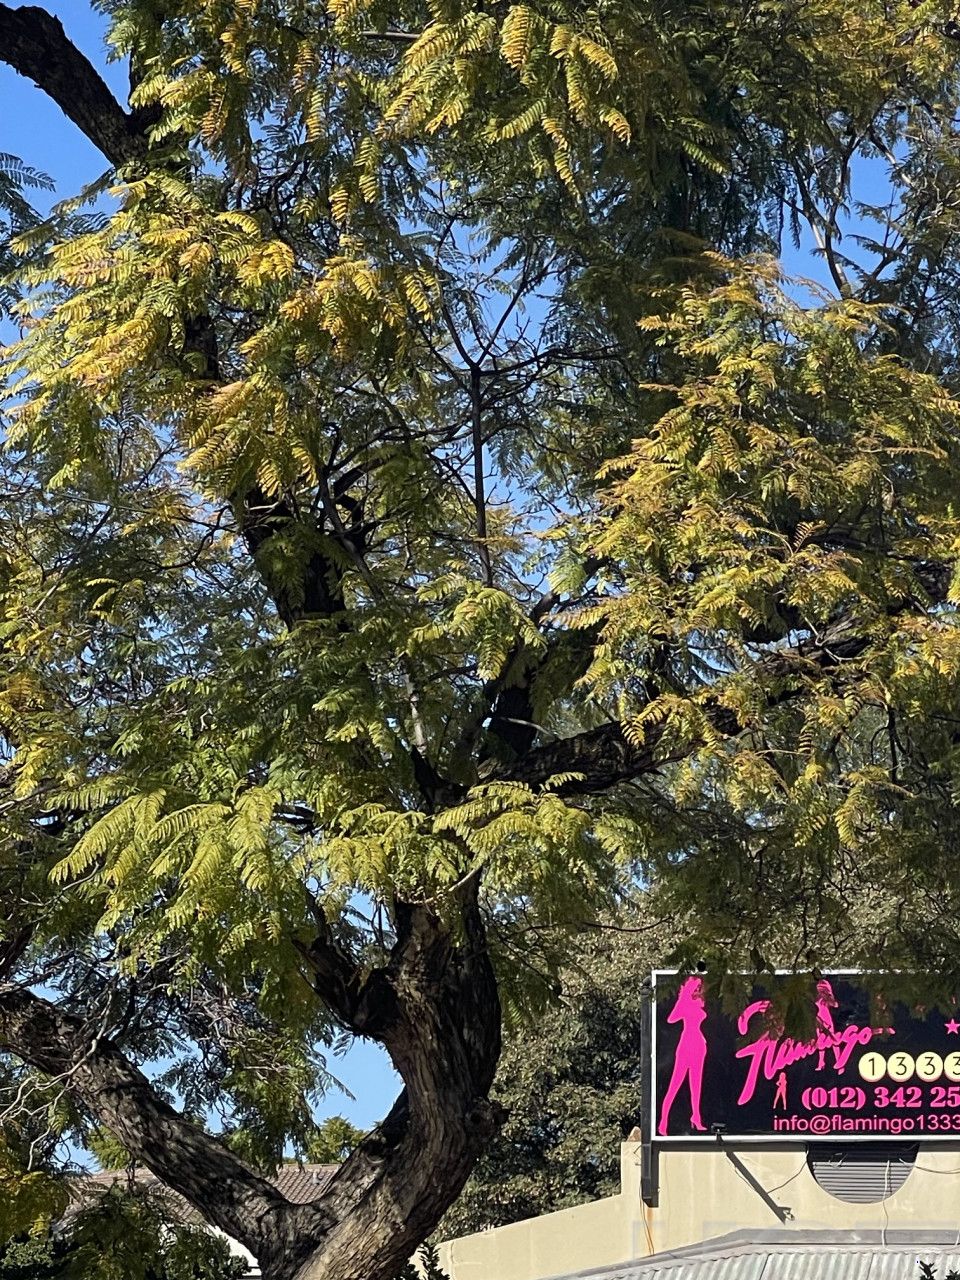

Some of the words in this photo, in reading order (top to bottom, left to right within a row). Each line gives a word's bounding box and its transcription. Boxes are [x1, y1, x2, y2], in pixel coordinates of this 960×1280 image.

[736, 1000, 895, 1106] Flamingo
[801, 1086, 866, 1110] (012)
[874, 1086, 923, 1107] 342
